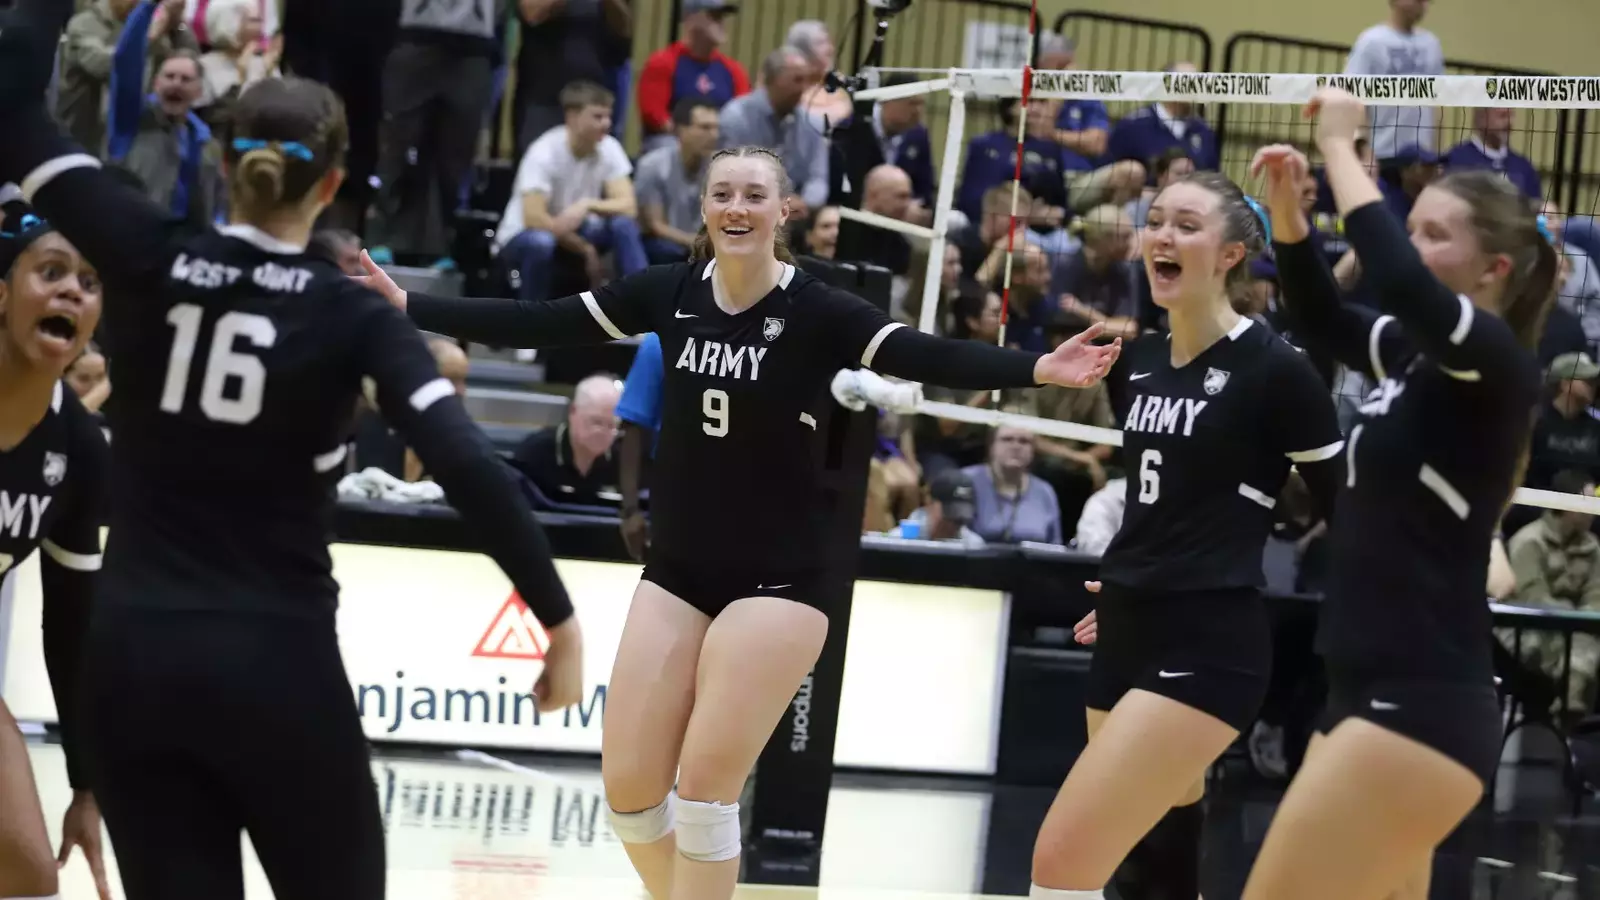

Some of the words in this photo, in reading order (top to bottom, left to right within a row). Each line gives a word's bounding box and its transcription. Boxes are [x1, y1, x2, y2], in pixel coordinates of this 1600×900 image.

[1498, 78, 1535, 100] ARMY
[1537, 79, 1576, 101] WEST
[160, 302, 277, 426] 16
[675, 337, 768, 381] ARMY
[702, 388, 729, 438] 9
[1124, 394, 1208, 437] ARMY
[1138, 449, 1163, 505] 6
[790, 666, 815, 752] mports
